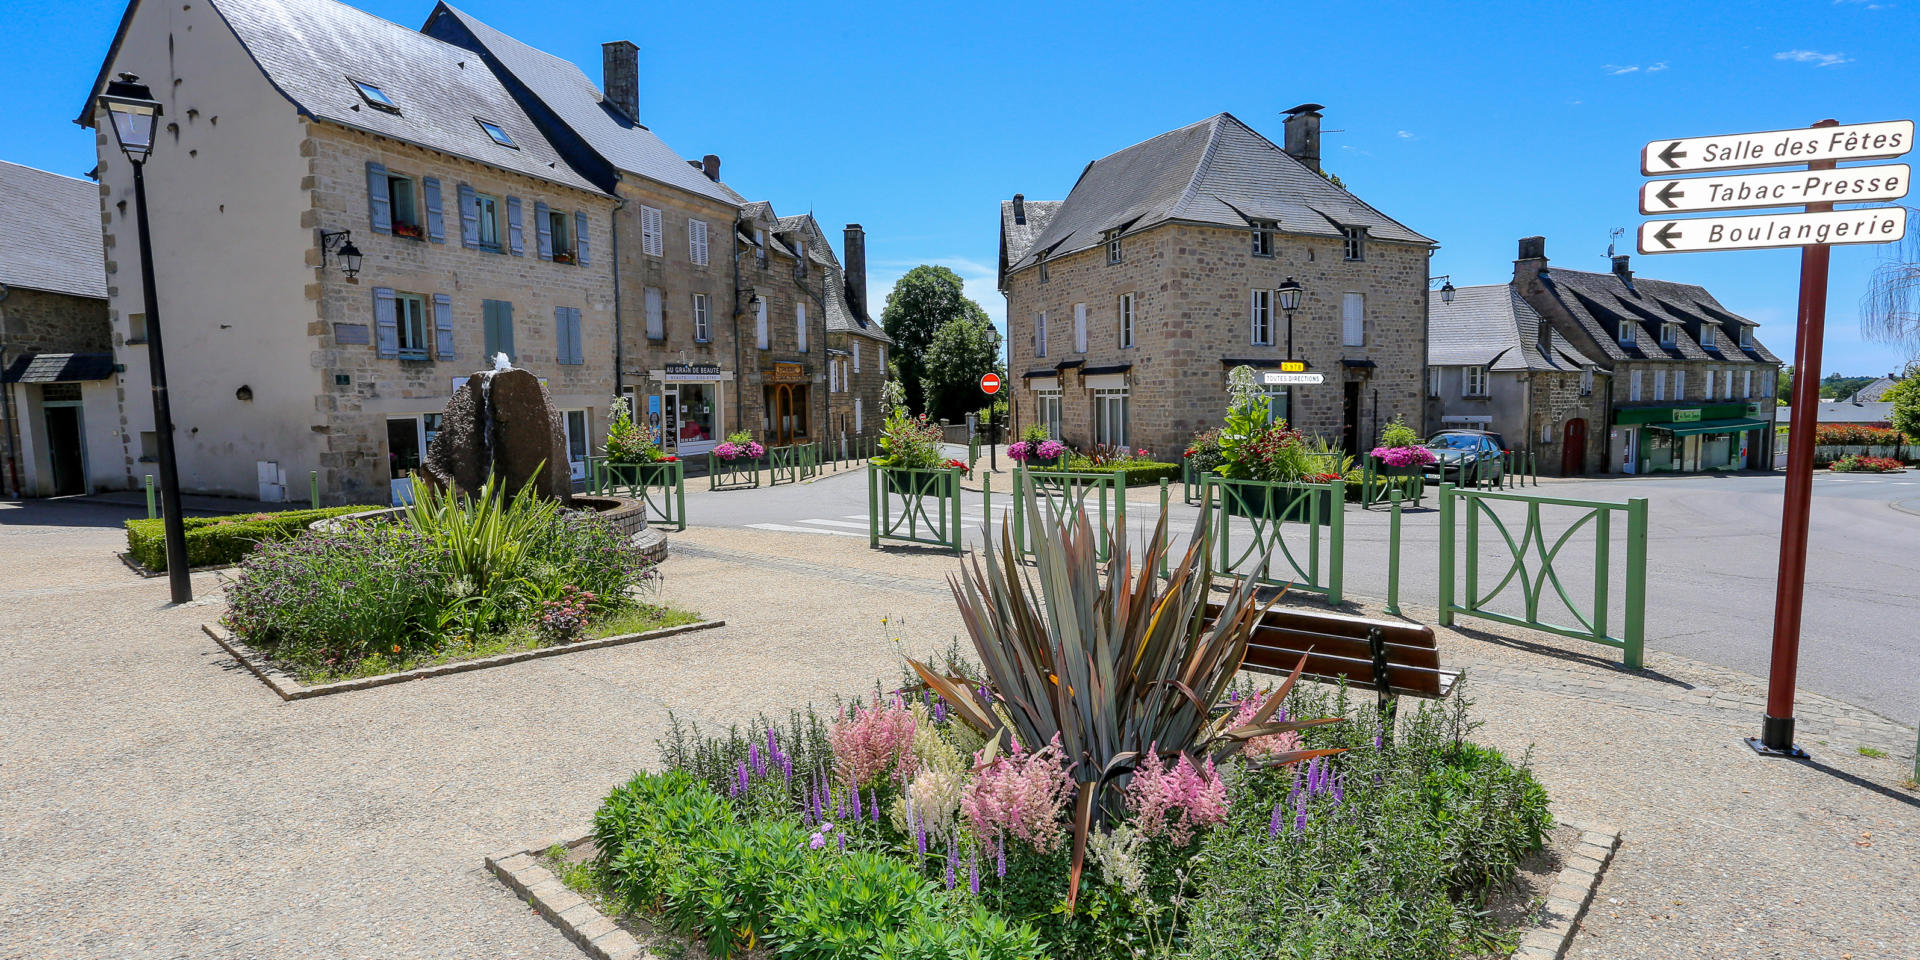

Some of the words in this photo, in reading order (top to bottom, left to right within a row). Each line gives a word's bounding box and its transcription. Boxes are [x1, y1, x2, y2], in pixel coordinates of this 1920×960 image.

[1703, 141, 1763, 162] Salle
[1774, 137, 1819, 157] des
[1828, 132, 1902, 153] Fêtes
[1708, 176, 1899, 202] Tabac-Presse
[1708, 215, 1895, 243] Boulangerie
[675, 366, 691, 374] GRAIN
